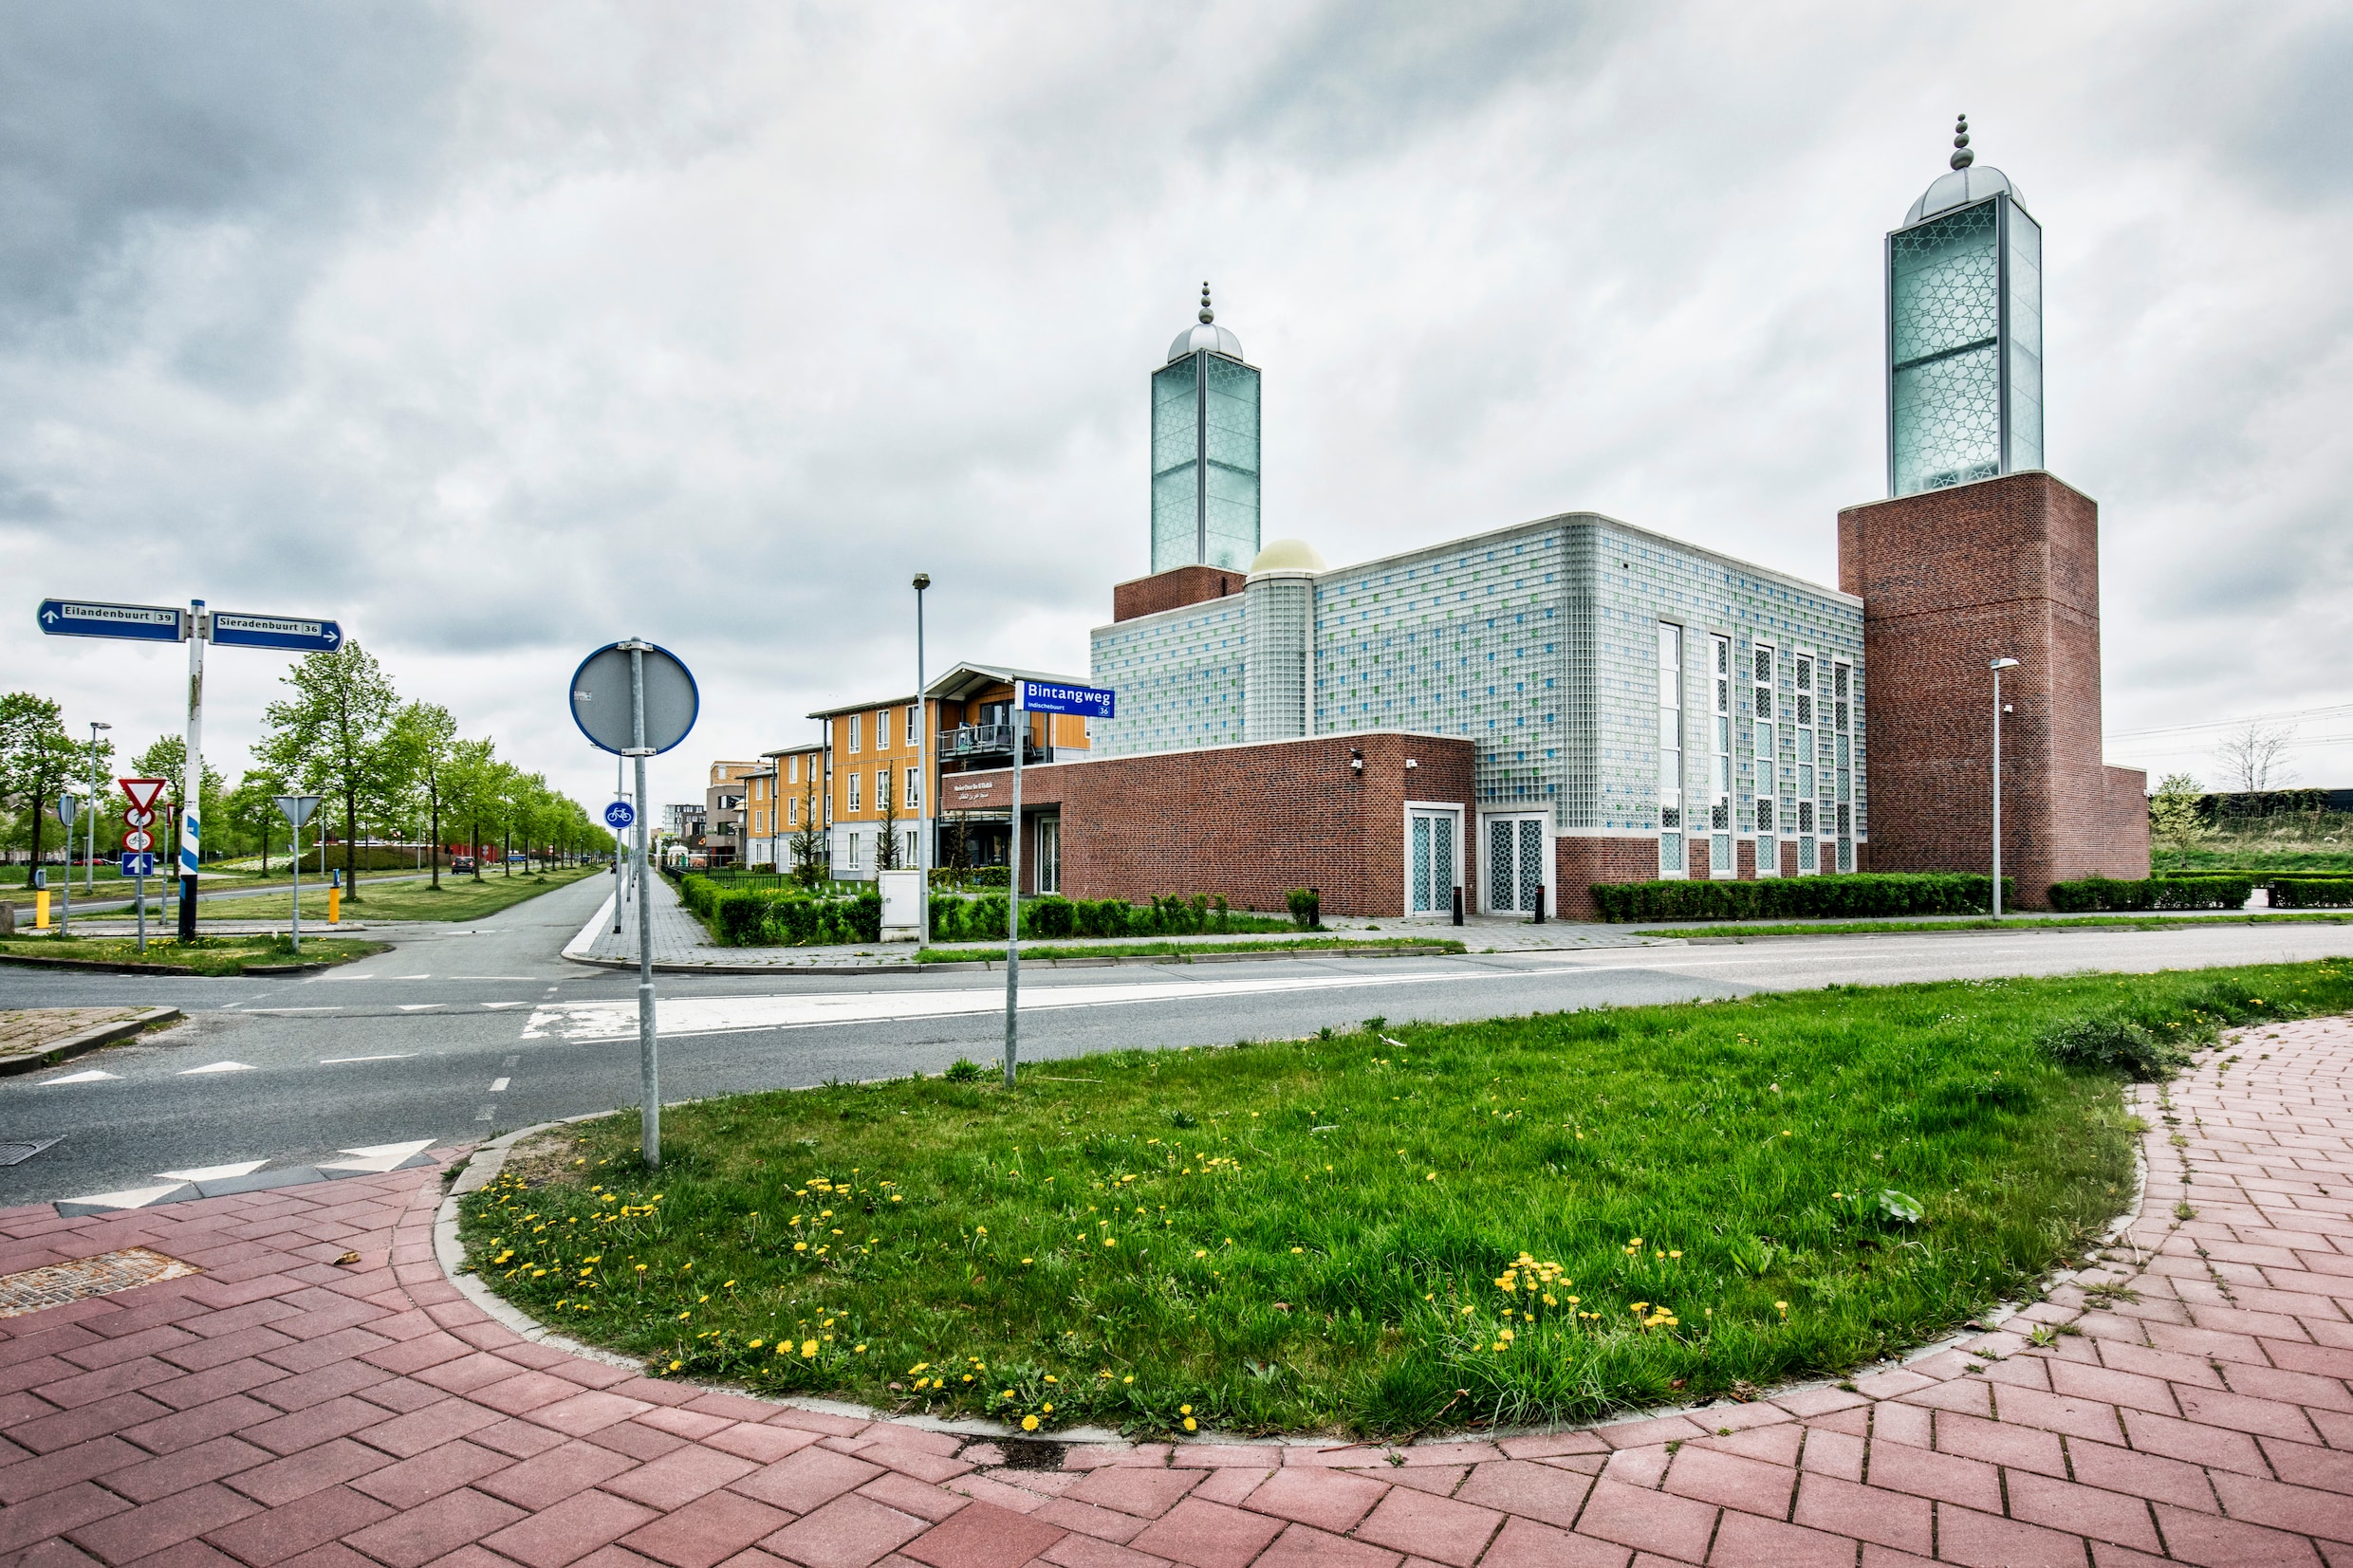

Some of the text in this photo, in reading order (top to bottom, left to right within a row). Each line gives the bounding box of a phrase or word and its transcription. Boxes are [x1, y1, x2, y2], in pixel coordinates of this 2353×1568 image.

[65, 606, 172, 622] Eilandenbuurt 39
[219, 618, 299, 632] Sieradenbuurt
[1028, 683, 1111, 706] Bintangweg
[1100, 707, 1109, 715] 36
